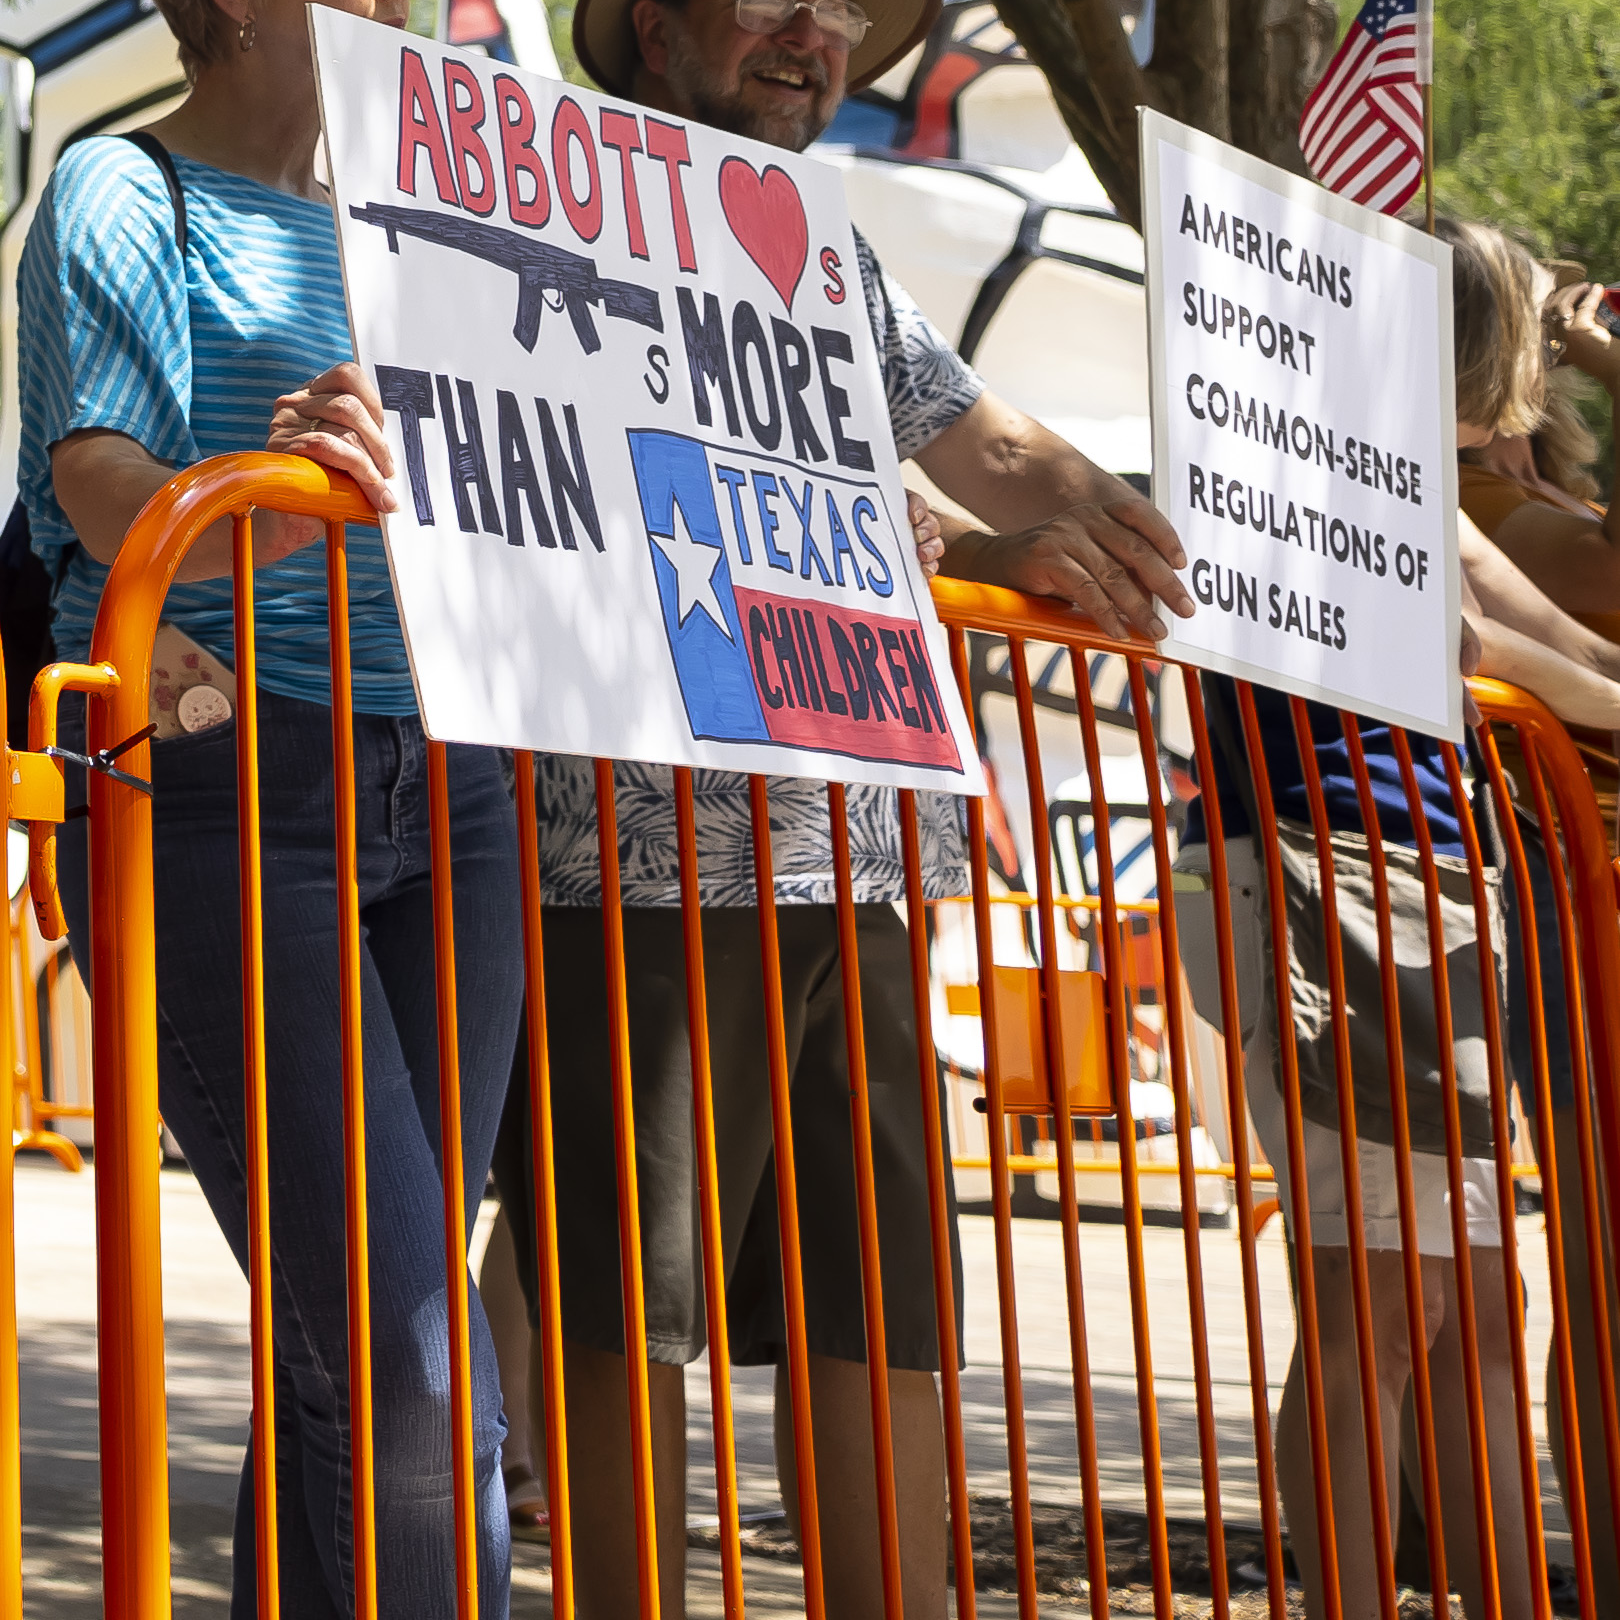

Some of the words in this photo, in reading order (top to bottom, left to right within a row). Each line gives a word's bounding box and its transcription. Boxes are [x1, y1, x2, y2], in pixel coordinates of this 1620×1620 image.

[396, 45, 699, 273] ABBOTT
[1180, 193, 1353, 309] AMERICANS
[675, 285, 876, 473] MORE
[1182, 281, 1315, 375] SUPPORT
[374, 364, 607, 554] THAN
[1186, 373, 1422, 505] COMMON-SENSE
[716, 467, 897, 599] TEXAS
[1188, 463, 1387, 578] REGULATIONS
[1395, 542, 1429, 592] OF
[747, 602, 946, 734] CHILDREN
[1191, 559, 1258, 622] GUN
[1268, 584, 1346, 651] SALES
